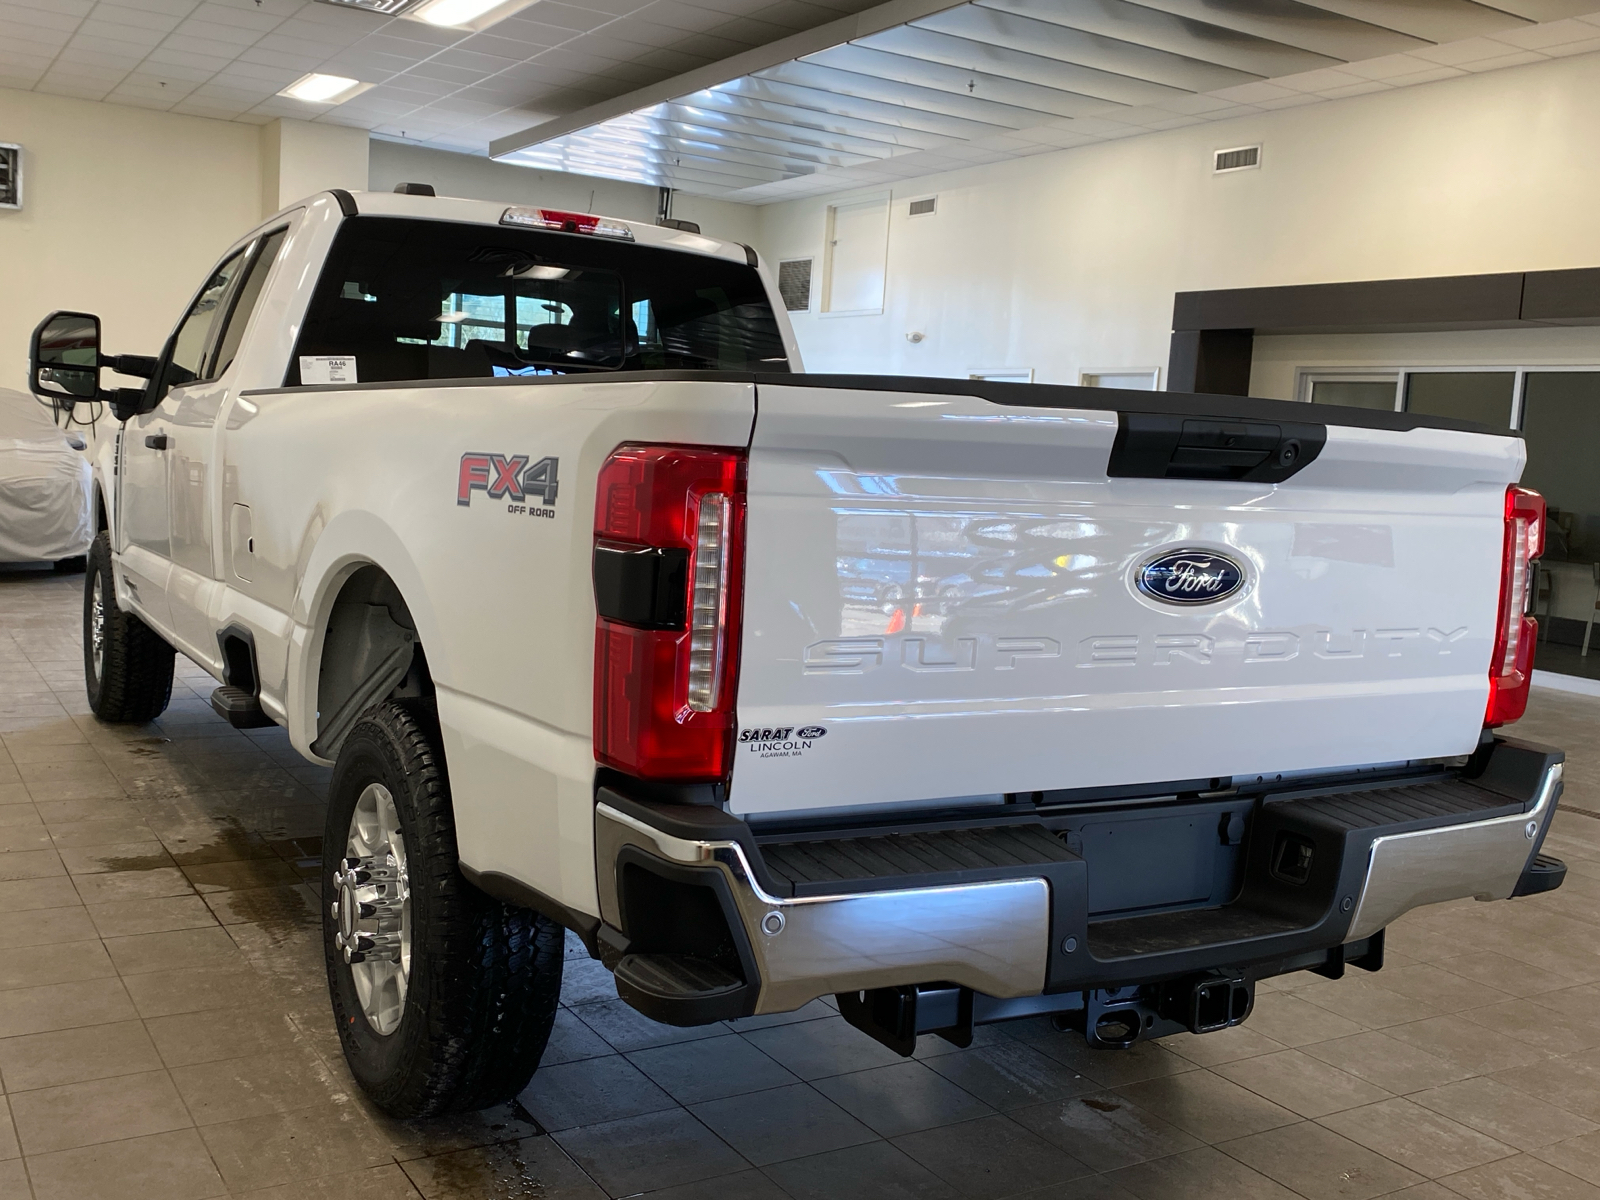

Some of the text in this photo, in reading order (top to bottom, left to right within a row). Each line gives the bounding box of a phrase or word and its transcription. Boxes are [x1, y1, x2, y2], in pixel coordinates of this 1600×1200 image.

[457, 451, 559, 506] FX4
[508, 504, 555, 518] OFF ROAD
[1165, 560, 1226, 592] Ford
[803, 625, 1469, 676] SUPER DUTY
[739, 727, 794, 743] SARAT
[750, 741, 811, 752] LINCOLN
